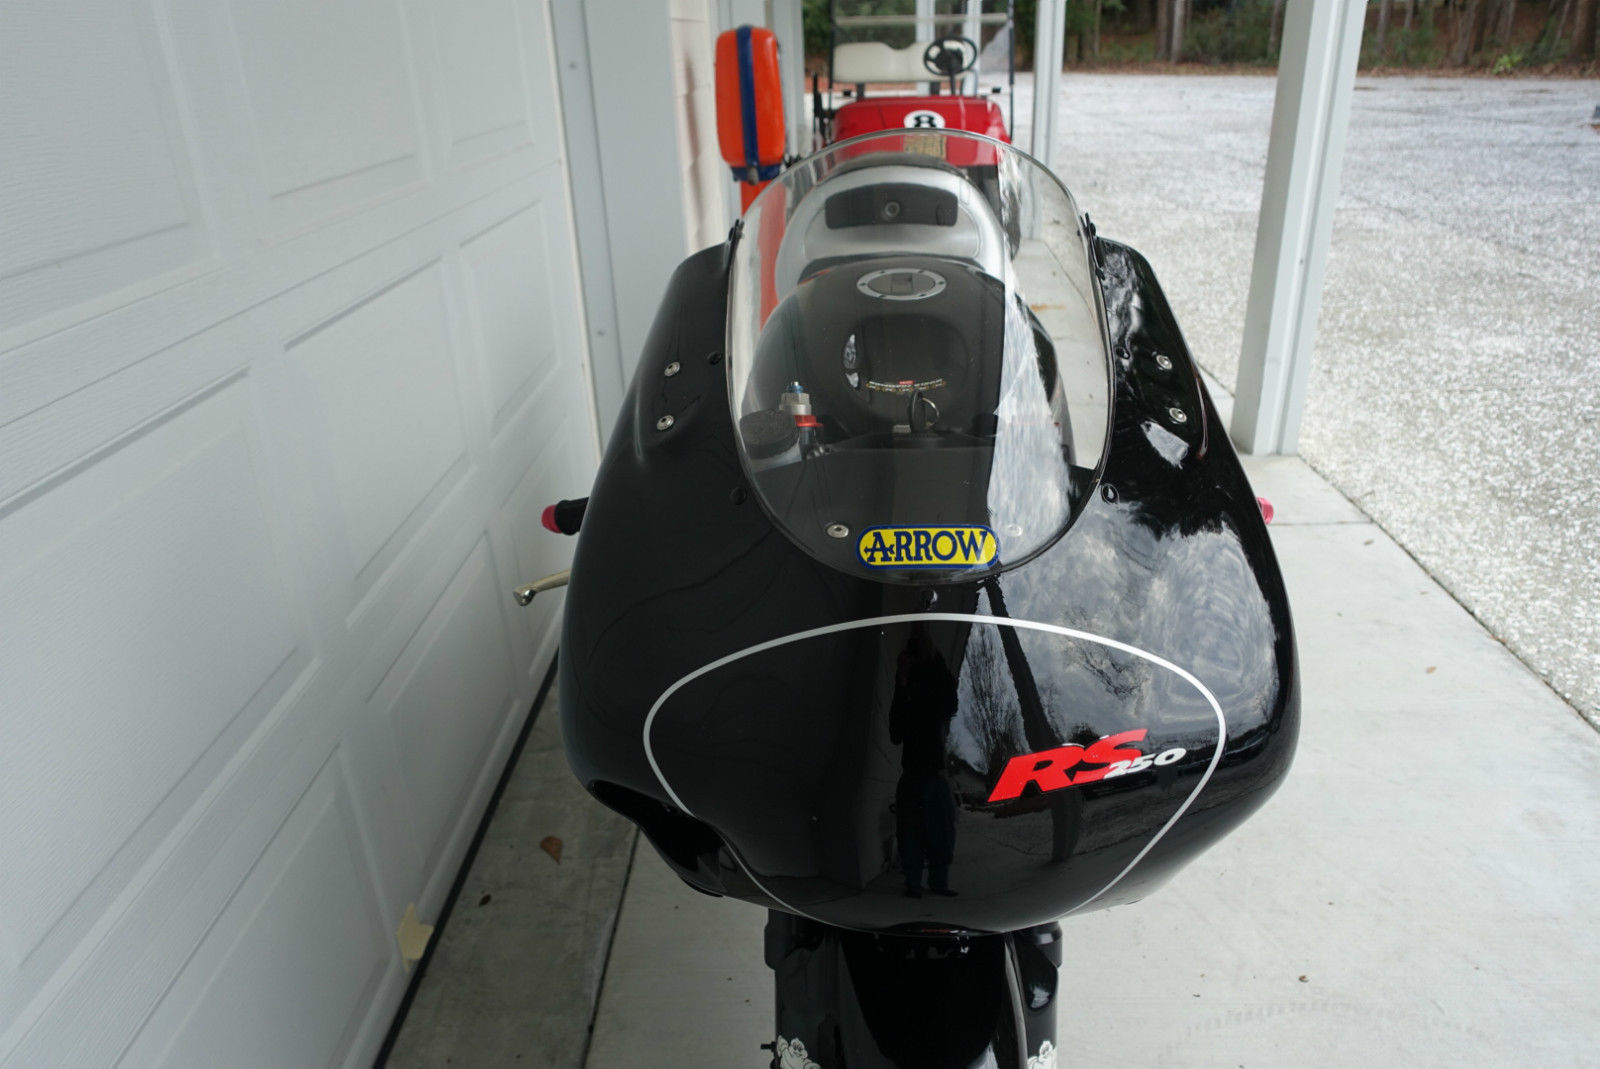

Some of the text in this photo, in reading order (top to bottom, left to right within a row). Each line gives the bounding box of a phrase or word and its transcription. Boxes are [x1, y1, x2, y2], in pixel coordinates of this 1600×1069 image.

[914, 114, 937, 128] 8
[863, 530, 988, 562] ARROW
[987, 728, 1187, 803] RS 250
